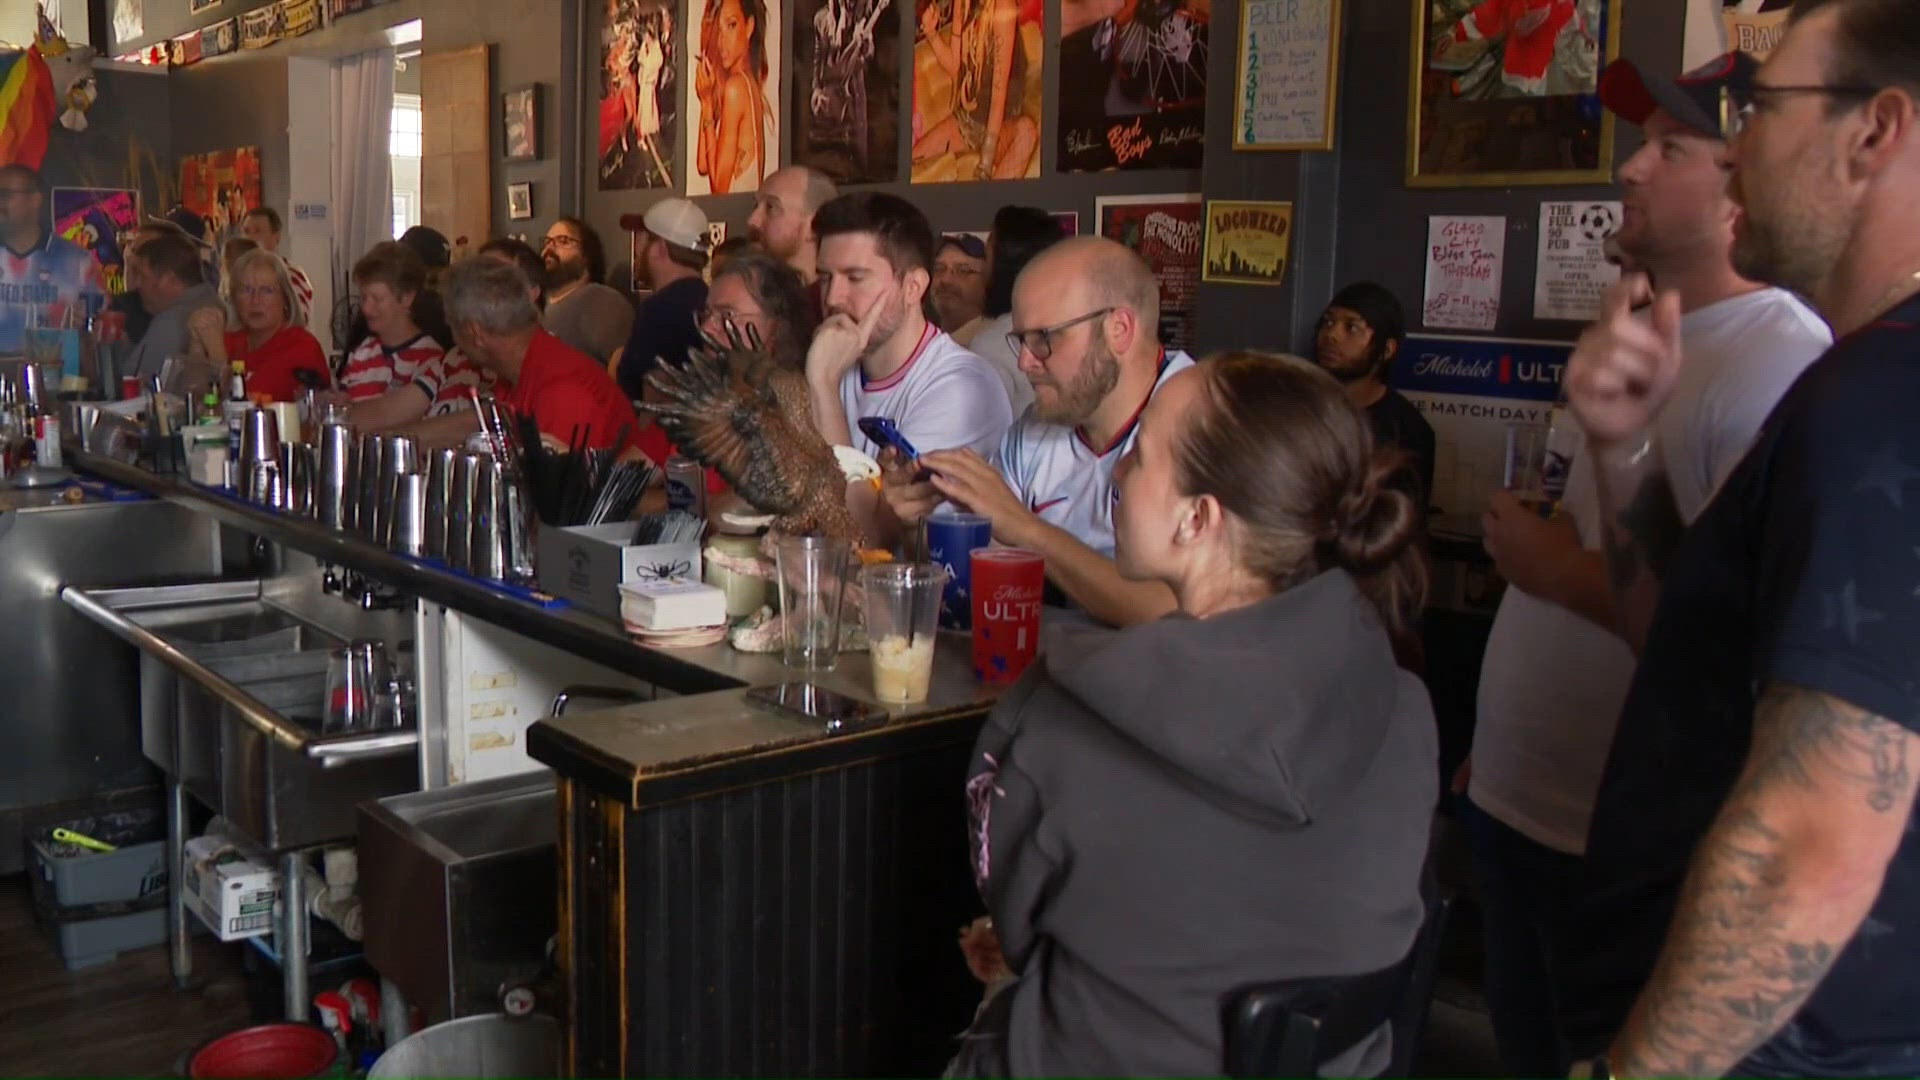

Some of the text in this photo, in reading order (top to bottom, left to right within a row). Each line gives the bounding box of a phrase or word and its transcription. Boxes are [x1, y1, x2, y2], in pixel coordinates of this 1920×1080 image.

[1249, 0, 1299, 25] BEER
[1248, 31, 1259, 50] 1
[1247, 53, 1260, 71] 2
[1246, 73, 1258, 91] 3
[1245, 88, 1256, 108] 4
[1107, 116, 1142, 148] Bad
[1244, 127, 1256, 144] 6
[1115, 135, 1153, 164] Boys
[1549, 205, 1573, 216] THE
[1215, 209, 1287, 237] LOCOWEED
[1442, 222, 1485, 237] GLASS
[1549, 216, 1577, 227] FULL
[1548, 228, 1562, 238] 90
[1547, 239, 1570, 250] PUB
[1415, 352, 1494, 379] Michelob
[1431, 402, 1495, 418] MATCH
[1500, 407, 1539, 422] DAY
